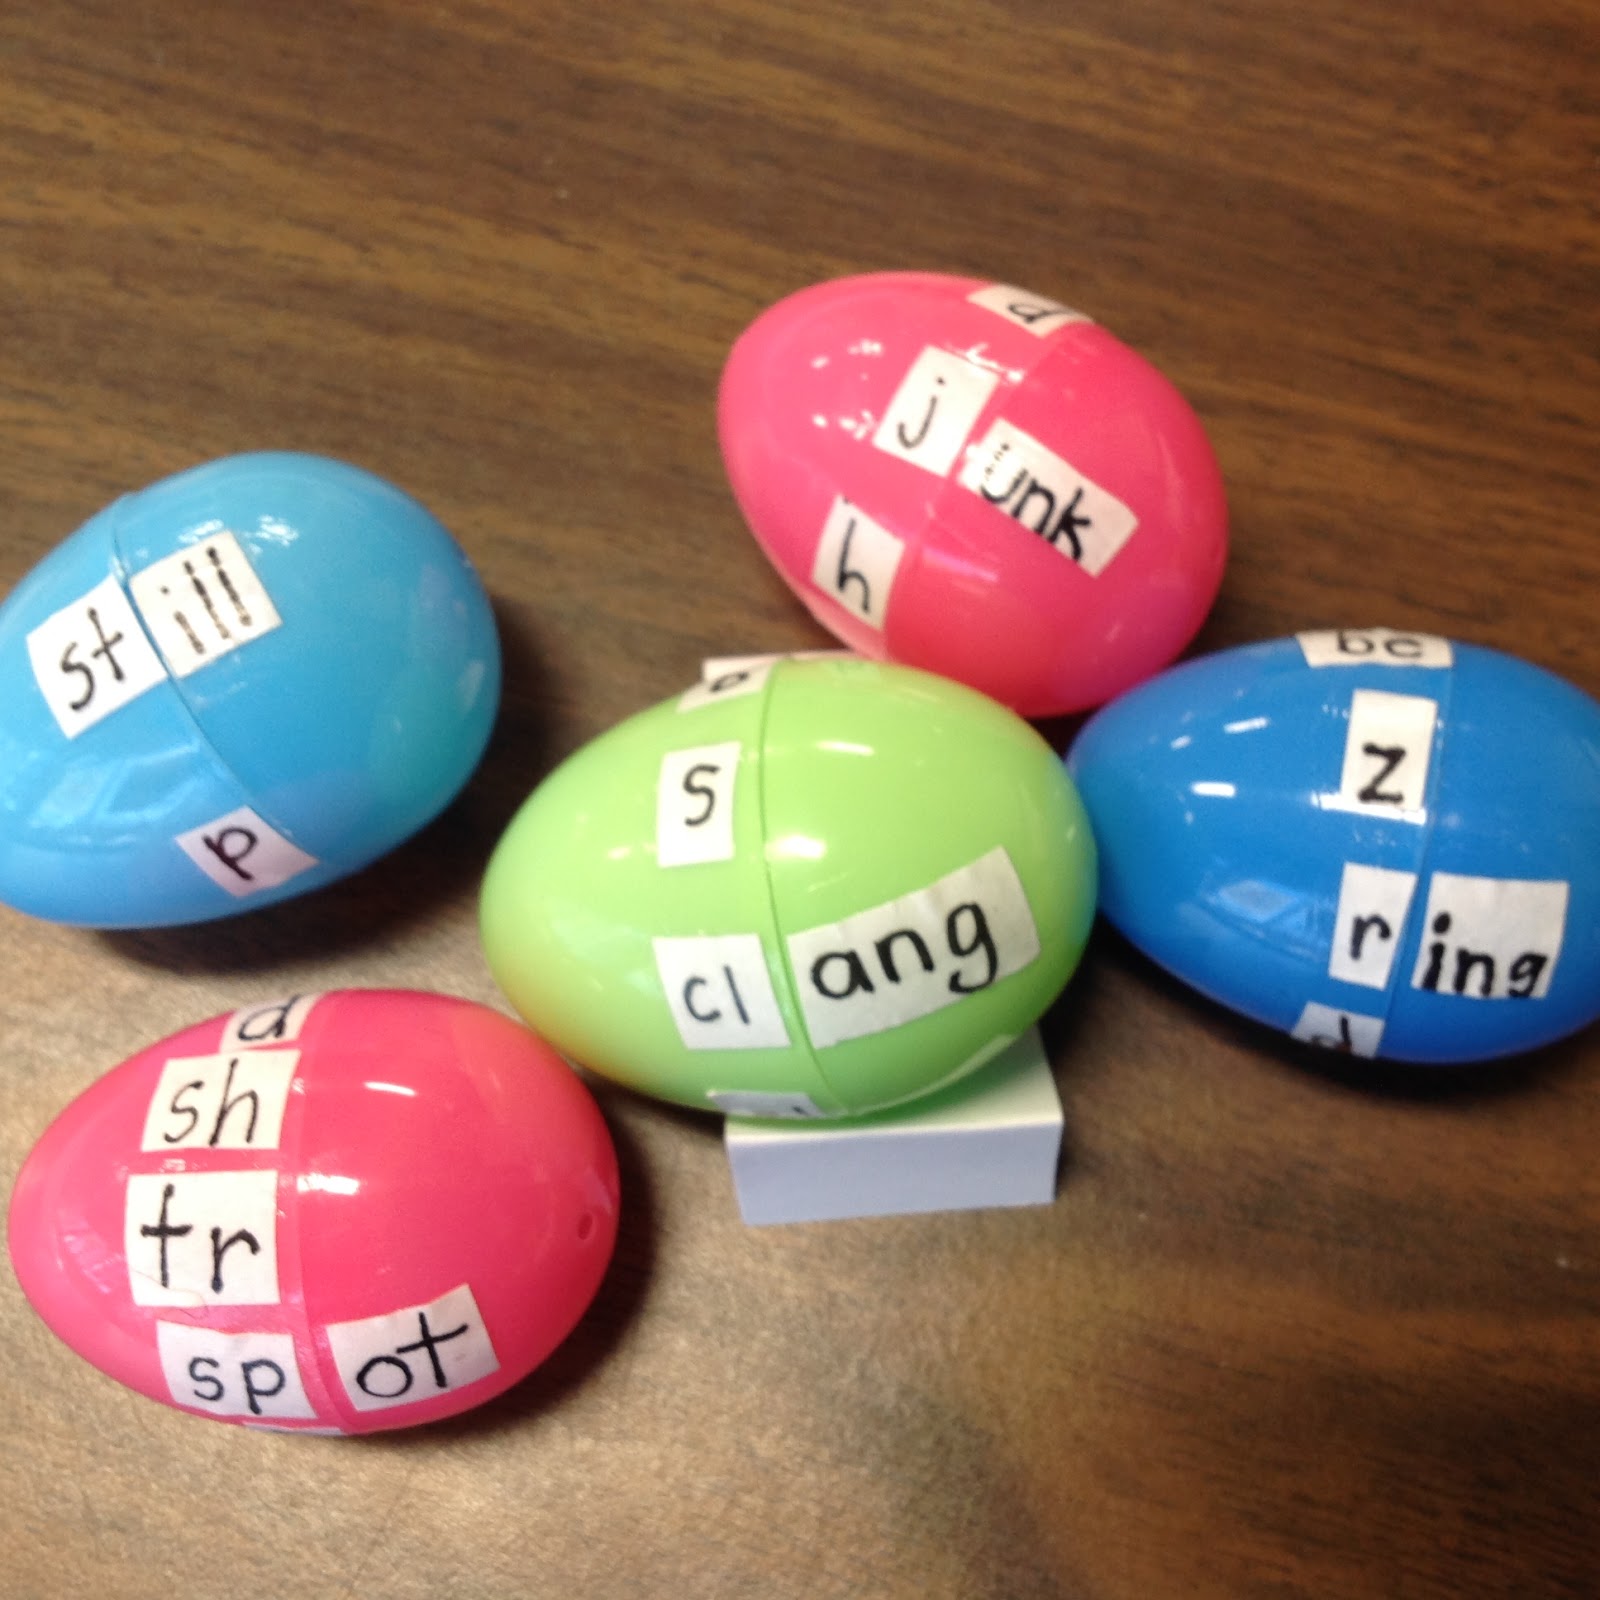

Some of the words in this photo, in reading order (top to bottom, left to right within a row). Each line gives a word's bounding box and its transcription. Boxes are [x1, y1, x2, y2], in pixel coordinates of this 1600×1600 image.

[897, 377, 947, 450] j
[837, 517, 872, 616] h
[59, 607, 125, 712] st
[1357, 741, 1406, 804] z
[202, 825, 259, 882] p
[810, 901, 998, 1000] ang
[1349, 912, 1392, 961] r
[1422, 912, 1548, 999] ing
[162, 1057, 259, 1148] sh
[140, 1182, 261, 1295] tr
[187, 1356, 287, 1416] sp
[355, 1311, 470, 1399] ot
